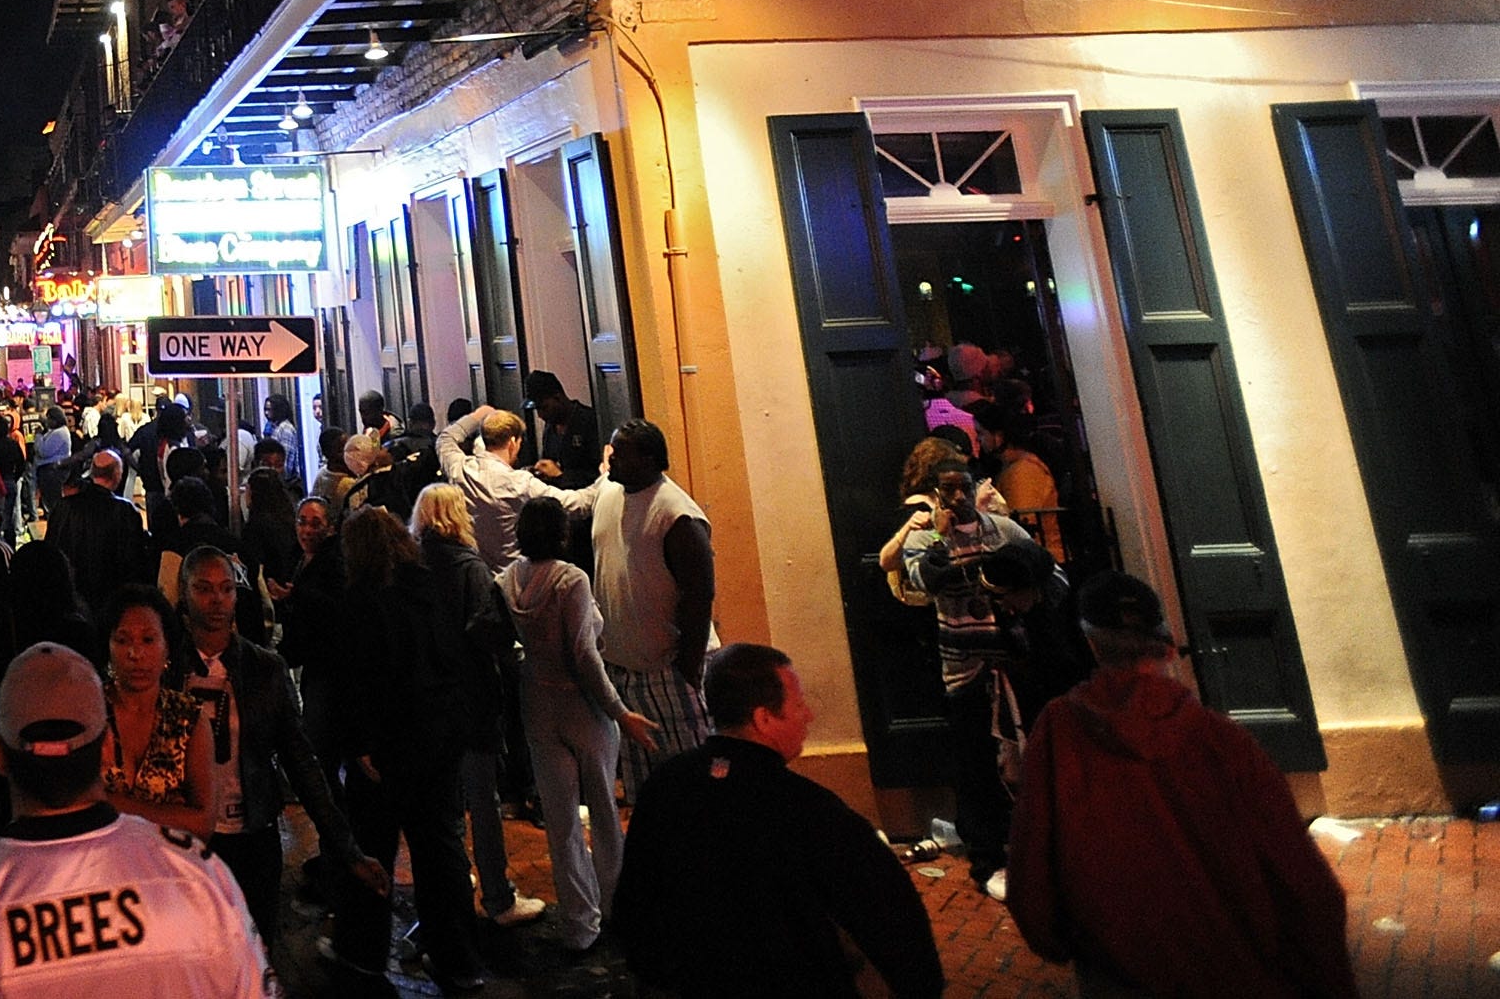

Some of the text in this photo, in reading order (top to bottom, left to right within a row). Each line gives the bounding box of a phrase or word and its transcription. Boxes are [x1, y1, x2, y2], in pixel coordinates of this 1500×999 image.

[165, 335, 266, 358] ONE WAY
[6, 887, 146, 968] BREES
